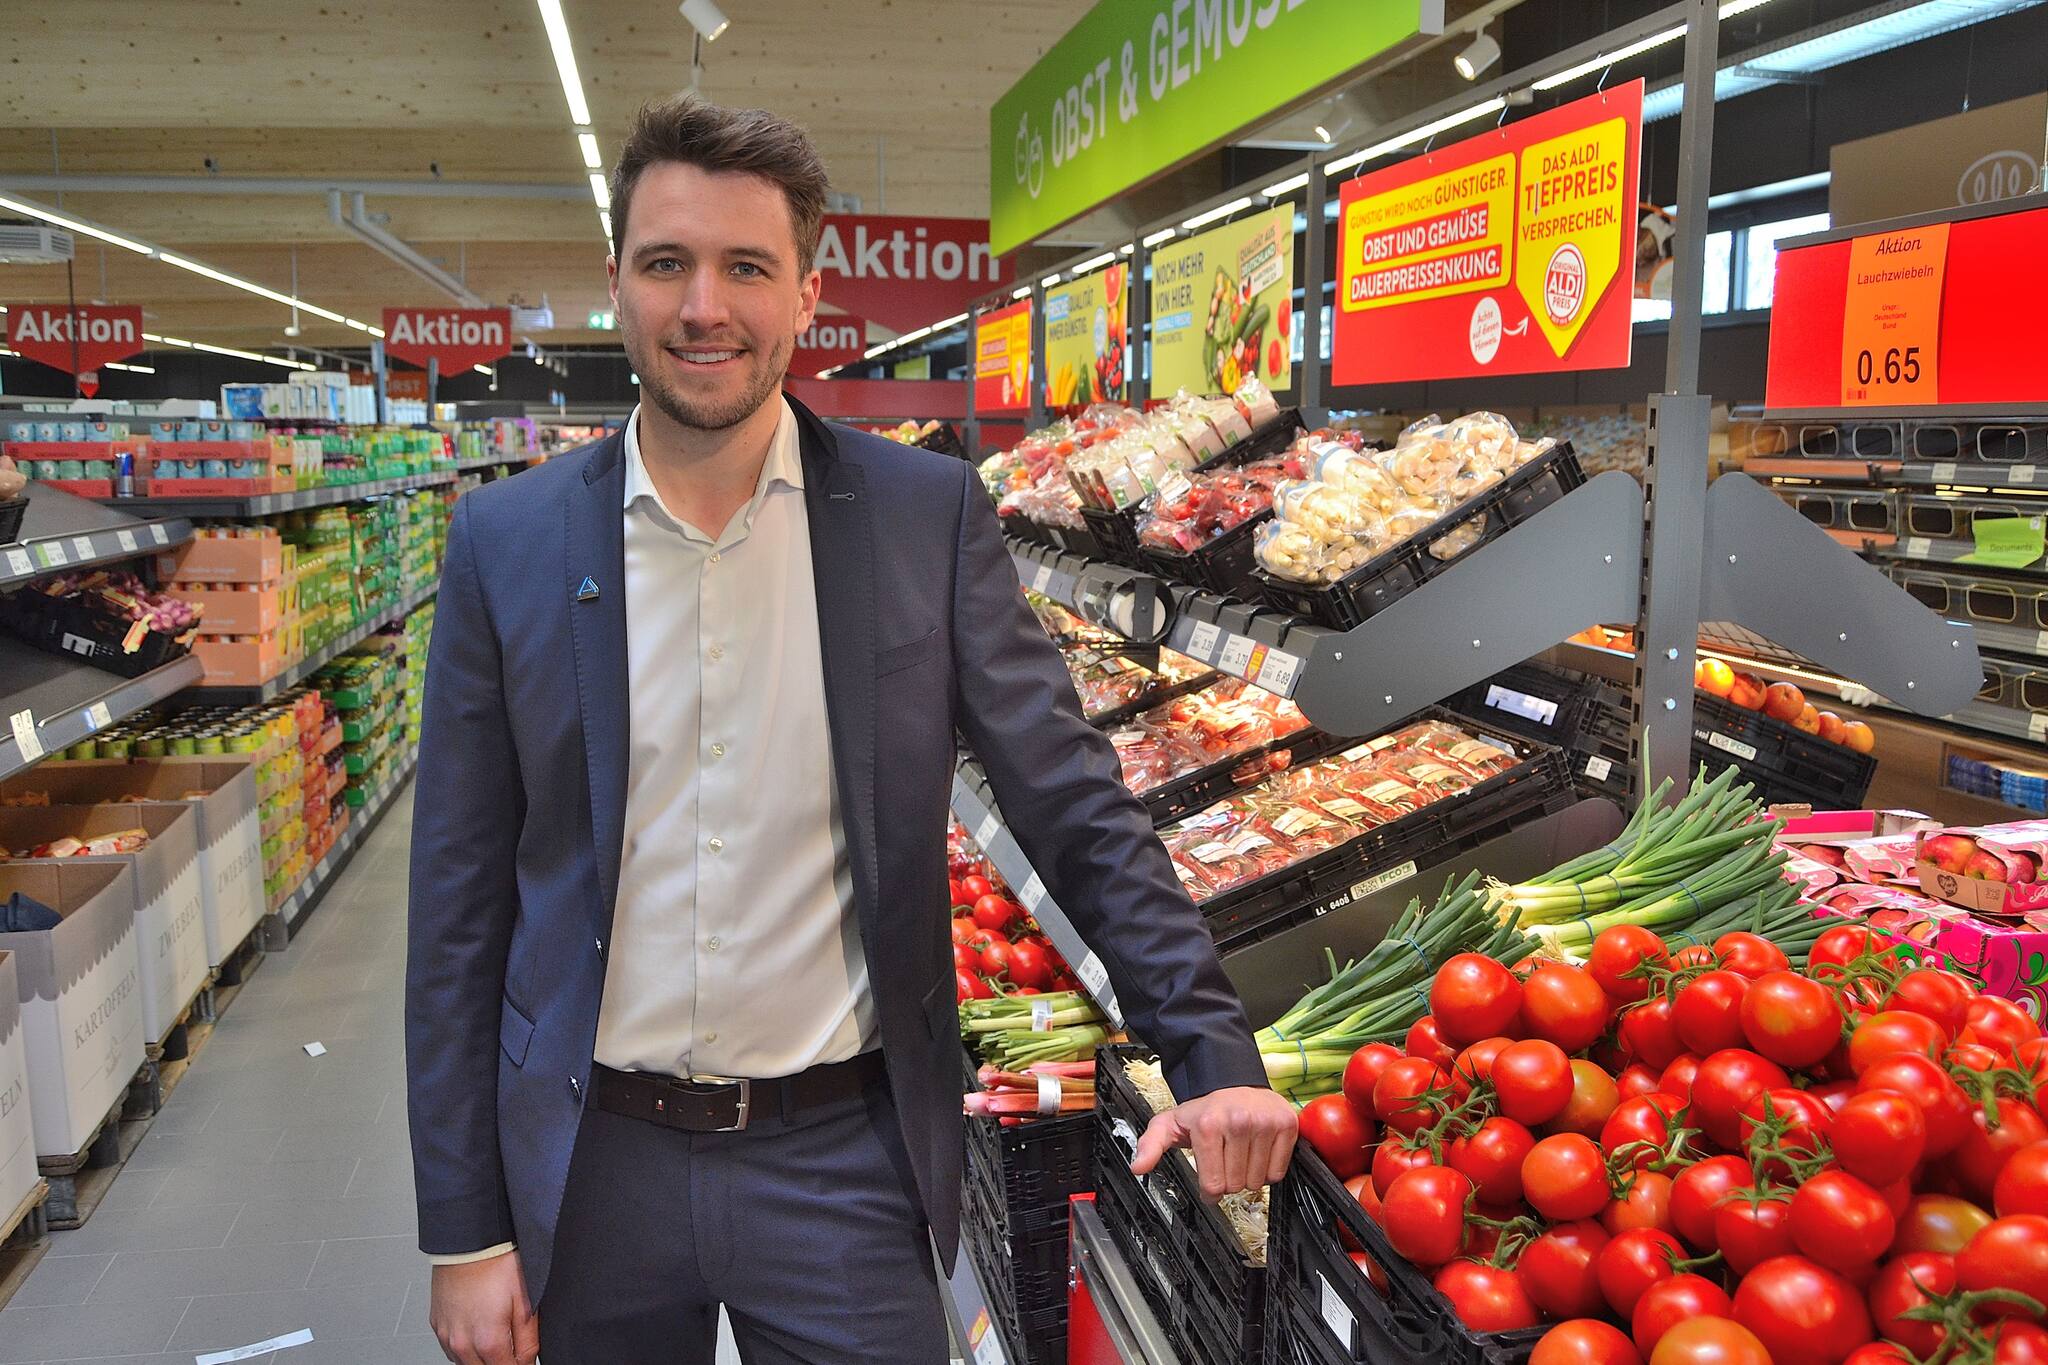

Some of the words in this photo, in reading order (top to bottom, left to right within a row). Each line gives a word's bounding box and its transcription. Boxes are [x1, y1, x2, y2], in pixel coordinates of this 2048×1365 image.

[1052, 57, 1111, 168] OBST
[1119, 40, 1139, 123] &
[1149, 0, 1307, 101] GEM
[1543, 154, 1567, 173] DAS
[1569, 142, 1599, 164] ALDI
[1350, 208, 1383, 230] GÜNSTIG
[1384, 203, 1406, 221] WIRD
[1407, 195, 1433, 214] NOCH
[1434, 167, 1509, 205] GÜNSTIGER.
[1525, 162, 1617, 214] TIEFPREIS
[1363, 234, 1396, 260] OBST
[1396, 226, 1425, 253] UND
[1427, 210, 1488, 246] GEMÜSE
[1522, 205, 1617, 241] VERSPRECHEN.
[815, 224, 999, 282] Aktion
[1875, 237, 1922, 256] Aktion
[1156, 259, 1177, 287] NOCH
[1179, 252, 1204, 279] MEHR
[1351, 249, 1500, 301] DAUERPREISSENKUNG.
[1553, 261, 1579, 273] ORIGINAL
[1857, 265, 1934, 285] Lauchzwiebeln
[1156, 289, 1171, 313] VON
[1171, 284, 1194, 312] HIER.
[1548, 273, 1581, 298] ALDI
[1552, 297, 1571, 309] PREIS
[15, 312, 135, 344] Aktion
[391, 314, 504, 346] Aktion
[796, 320, 858, 350] tion
[1857, 346, 1921, 385] 0.65
[217, 843, 261, 894] ZWIEBELN
[1379, 868, 1403, 884] IFCO
[1315, 906, 1328, 916] LL
[1329, 894, 1350, 910] 6408
[157, 895, 201, 958] ZWIEBELN
[74, 967, 138, 1050] KARTOFFELN
